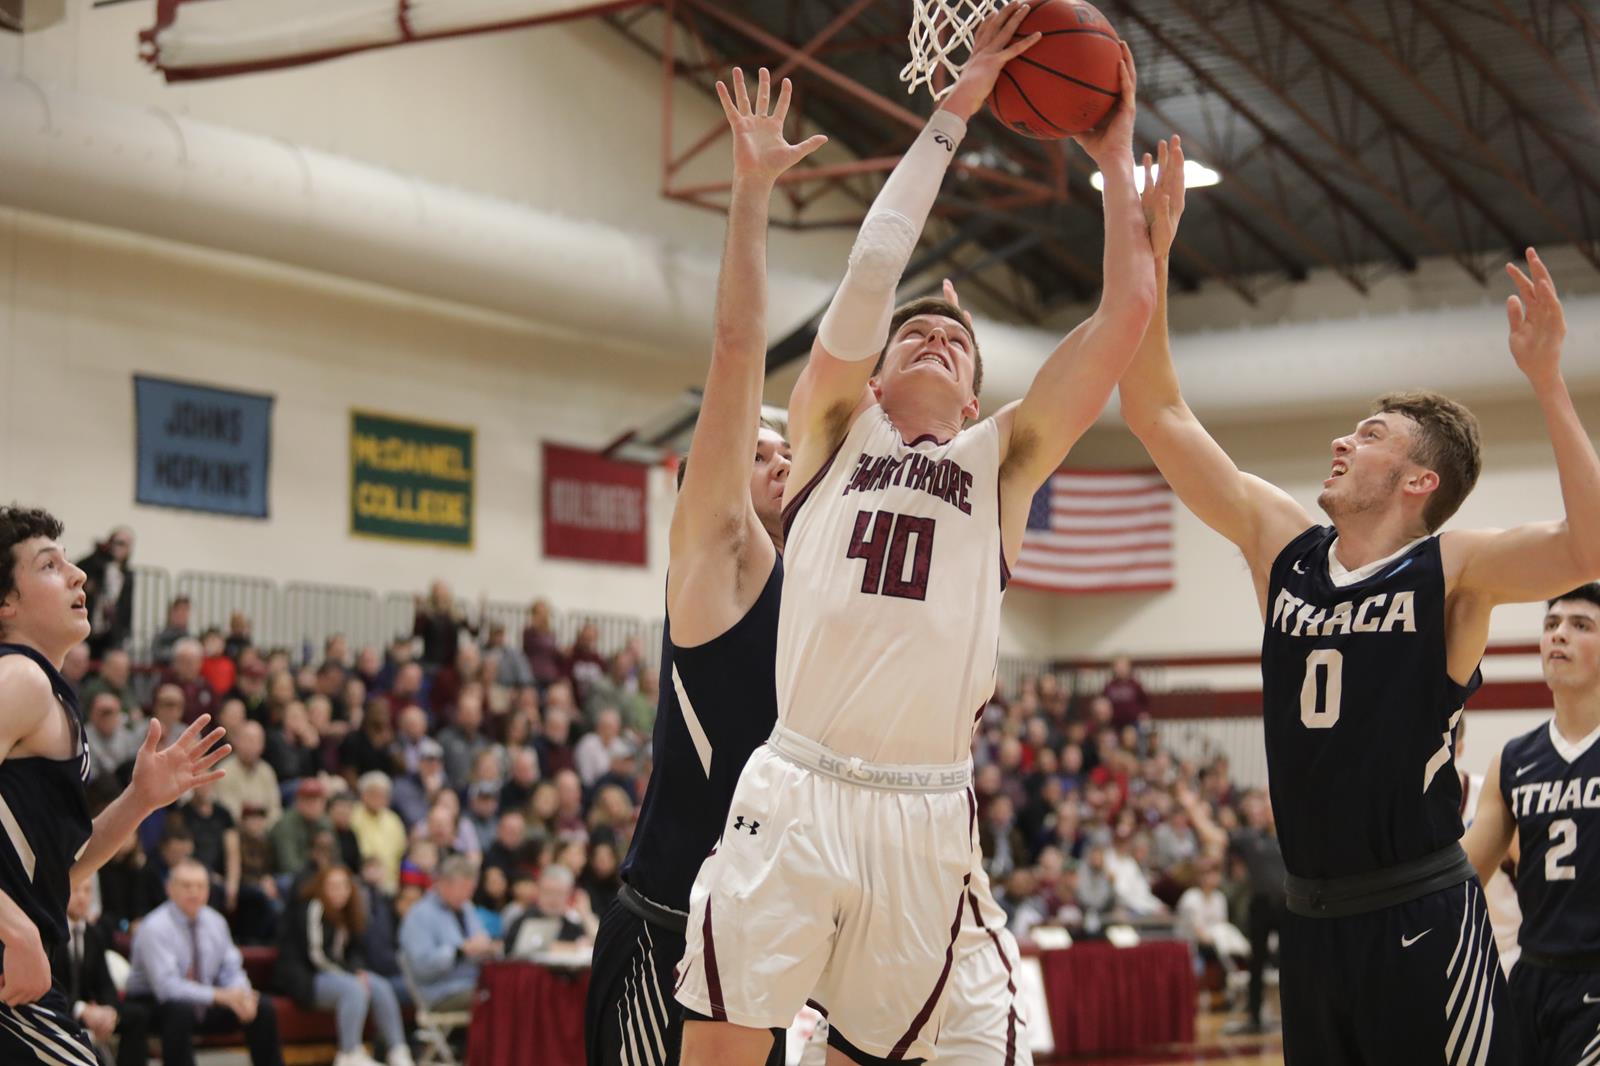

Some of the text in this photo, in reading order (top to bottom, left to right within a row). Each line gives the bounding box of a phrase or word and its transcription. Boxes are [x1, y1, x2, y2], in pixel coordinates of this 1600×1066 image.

[164, 401, 242, 446] JOHNS
[154, 452, 250, 499] HOPKINS
[359, 483, 464, 526] COLLEGE
[847, 510, 936, 601] 40
[1273, 587, 1417, 637] ITHACA
[1300, 648, 1343, 728] 0
[1512, 777, 1600, 819] ITHAC
[1545, 818, 1577, 881] 2
